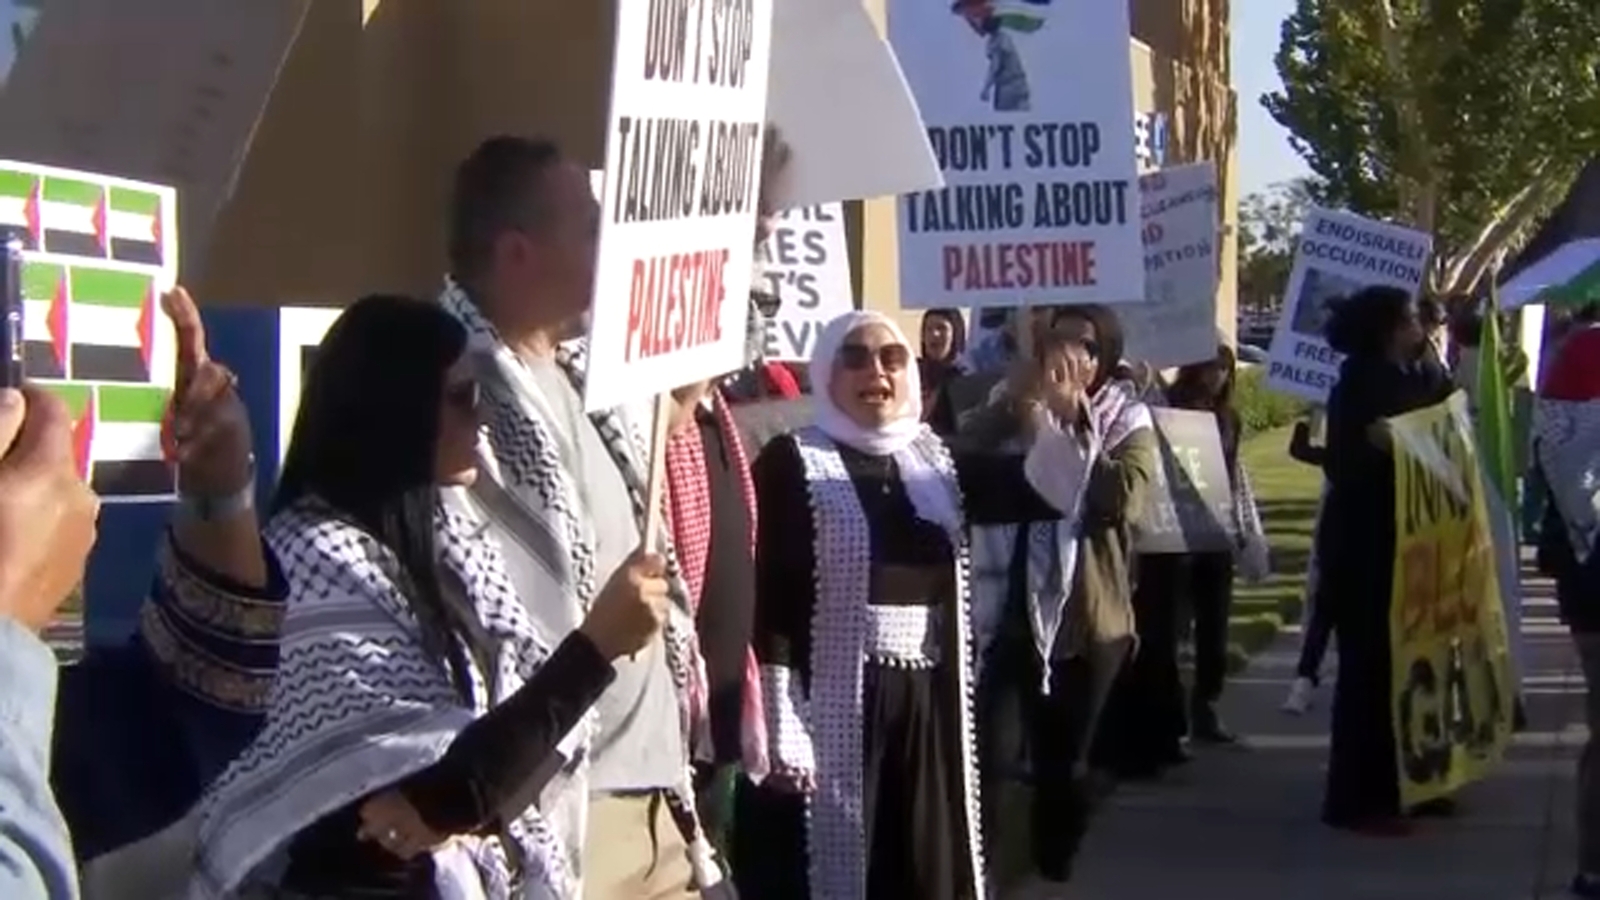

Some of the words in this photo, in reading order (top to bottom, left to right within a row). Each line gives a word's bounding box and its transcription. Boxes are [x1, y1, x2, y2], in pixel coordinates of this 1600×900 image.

[644, 0, 704, 83] DONT
[708, 0, 753, 88] STOP
[614, 116, 700, 224] TALKING
[699, 120, 759, 217] ABOUT
[928, 124, 1015, 171] DON'T
[1024, 122, 1100, 168] STOP
[903, 183, 1023, 233] TALKING
[1033, 181, 1128, 228] ABOUT
[764, 228, 826, 265] ES
[1302, 240, 1421, 284] OCCUPATION
[1316, 219, 1424, 260] ENDISRAELI
[942, 241, 1096, 291] PALESTINE
[624, 249, 730, 363] PALESTINE
[1294, 341, 1337, 366] FREE
